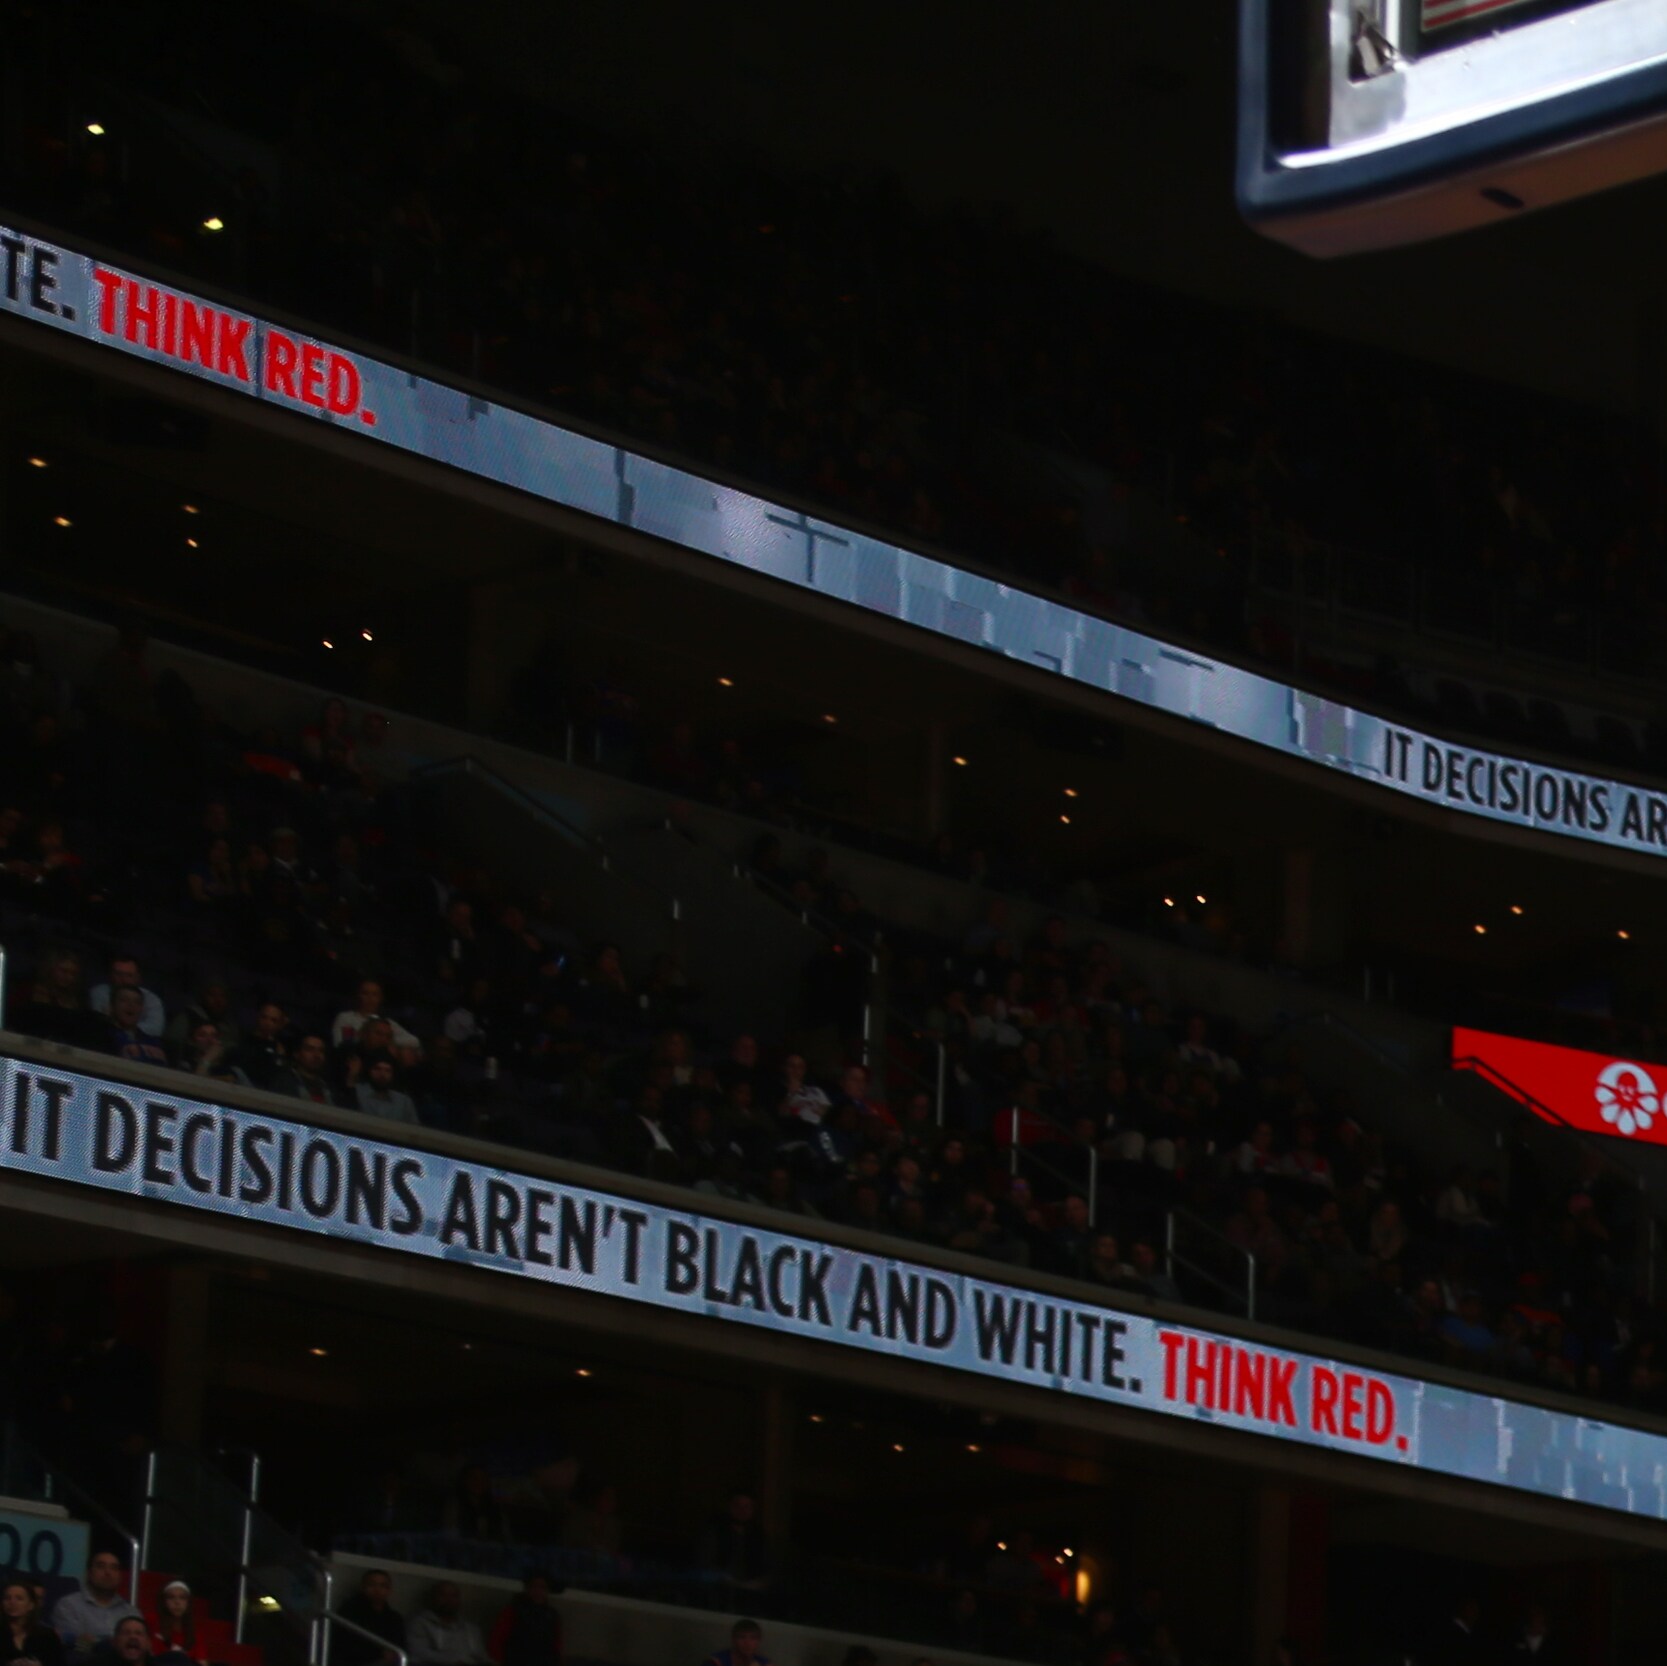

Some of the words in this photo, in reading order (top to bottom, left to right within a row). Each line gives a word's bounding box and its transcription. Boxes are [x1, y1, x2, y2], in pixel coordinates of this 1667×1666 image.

[93, 266, 251, 383] THINK
[264, 331, 376, 427] RED.
[1384, 728, 1414, 782] IT
[1422, 741, 1610, 832] DECISIONS
[11, 1070, 72, 1162] IT
[93, 1089, 425, 1236] DECISIONS
[440, 1170, 647, 1285] AREN'T
[664, 1218, 833, 1328] BLACK
[848, 1262, 958, 1351] AND
[973, 1287, 1143, 1393] WHITE.
[1159, 1330, 1298, 1427] THINK
[1311, 1368, 1410, 1451] RED.
